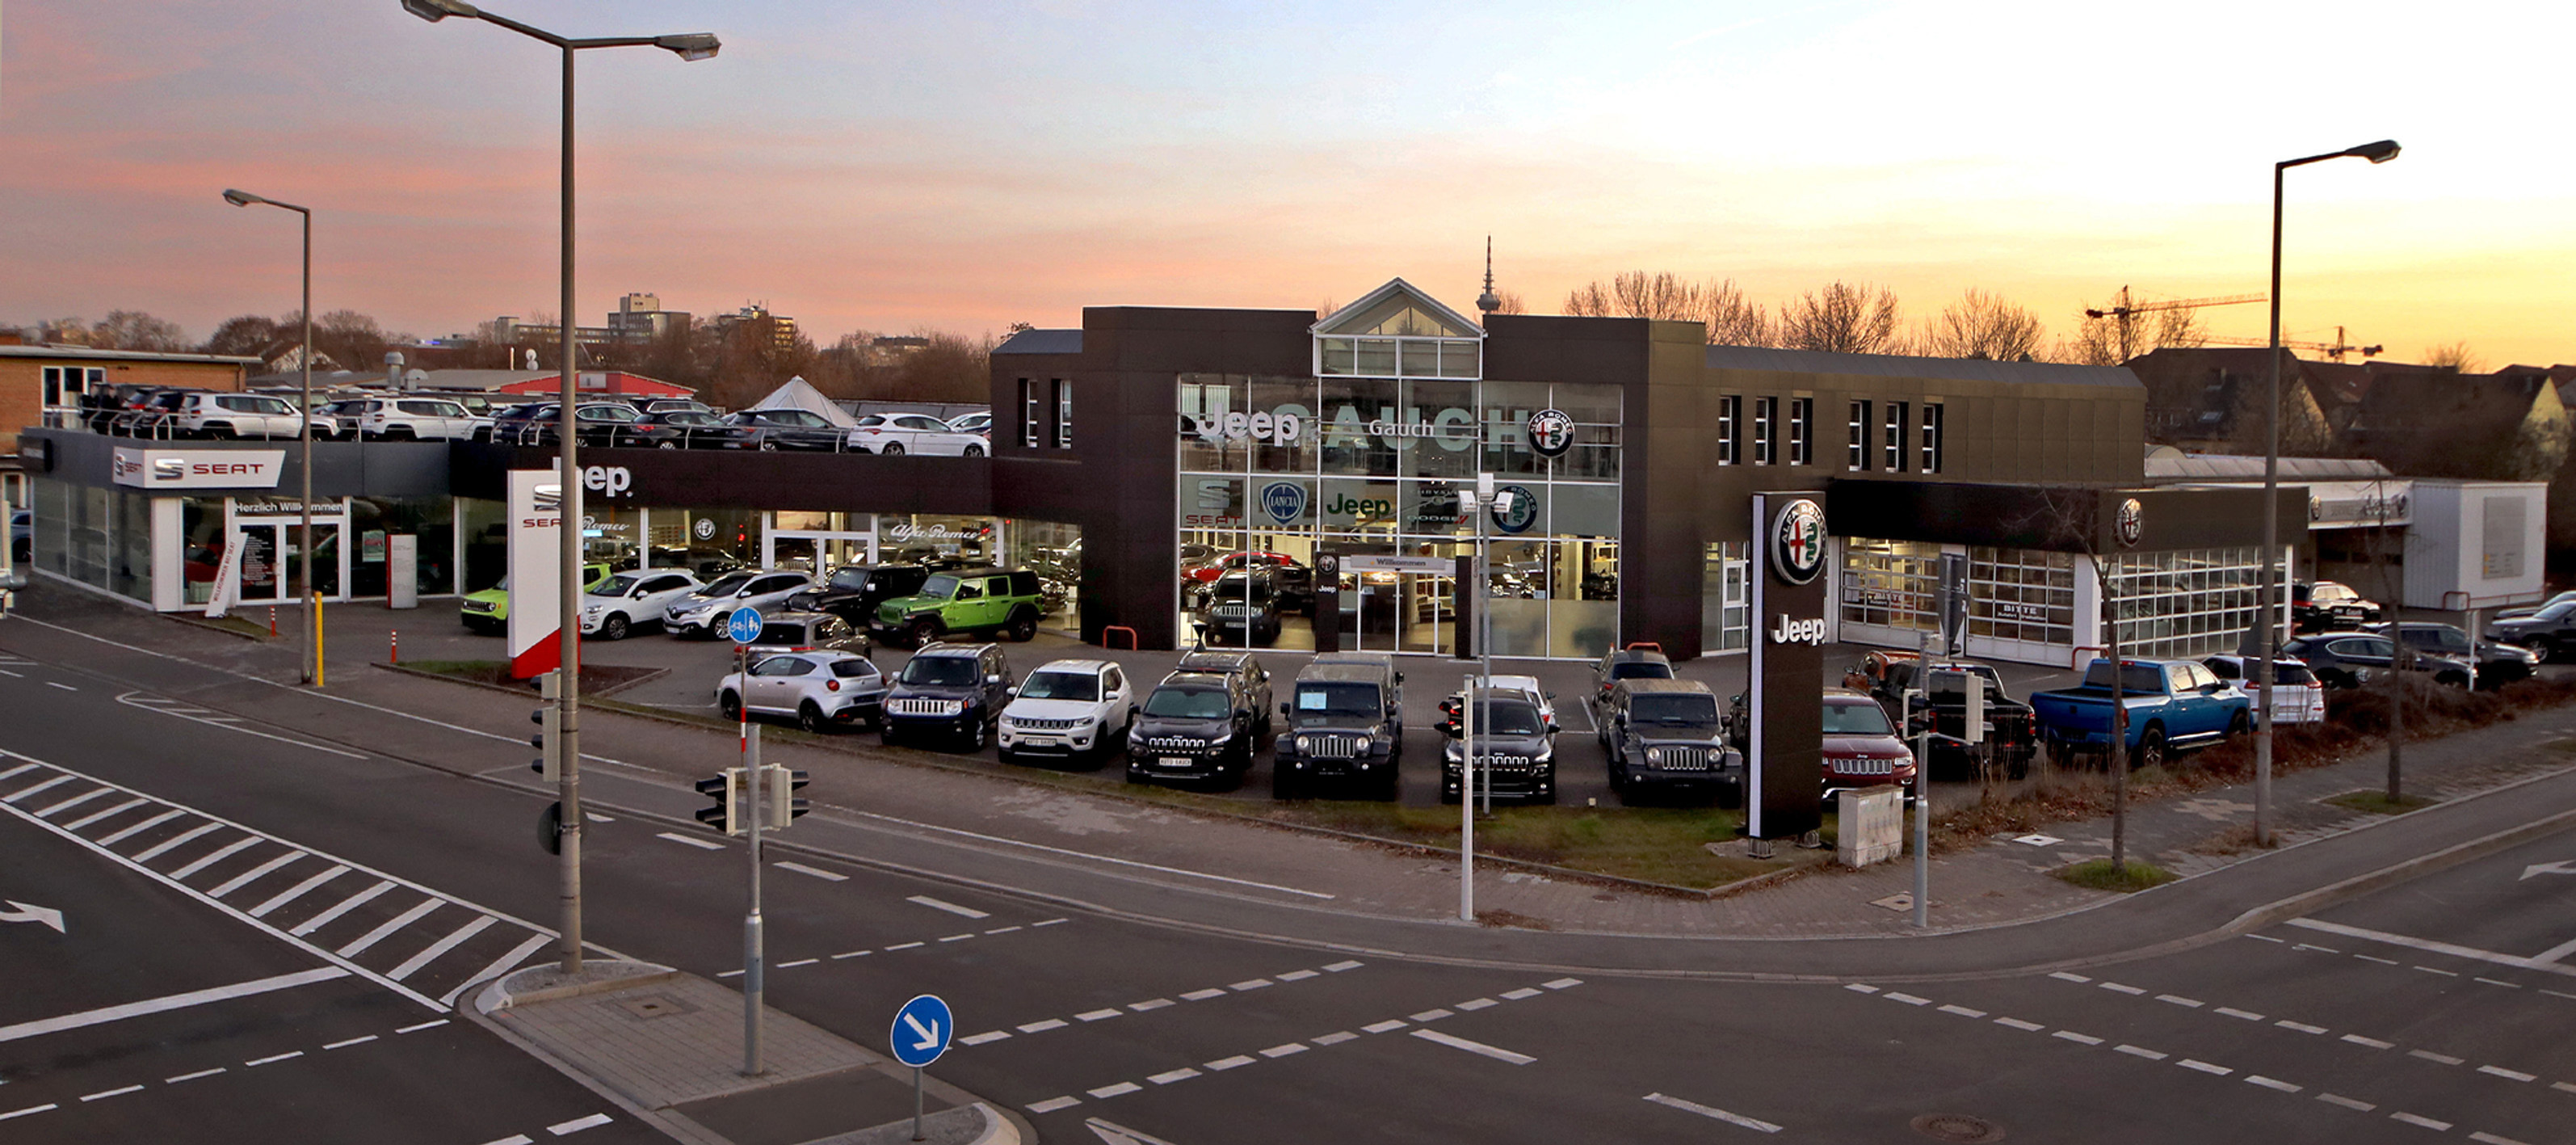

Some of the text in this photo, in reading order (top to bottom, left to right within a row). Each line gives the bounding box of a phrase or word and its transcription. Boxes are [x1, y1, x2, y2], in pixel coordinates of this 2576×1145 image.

[1196, 403, 1300, 447] Jeep
[1369, 419, 1435, 437] Gauch
[193, 464, 264, 475] SEAT
[1270, 495, 1298, 507] LANCIA
[1511, 486, 1537, 511] ROMEO
[235, 501, 343, 512] Herzlich Willkmmen
[1326, 494, 1391, 520] Jeep
[523, 518, 561, 528] SEA
[1186, 515, 1242, 524] SEAT
[890, 524, 981, 542] Alfa Romeo
[1781, 511, 1800, 544] ALFA
[1317, 585, 1337, 594] Jeep
[2003, 604, 2037, 615] BITTE
[1774, 613, 1825, 646] Jeep
